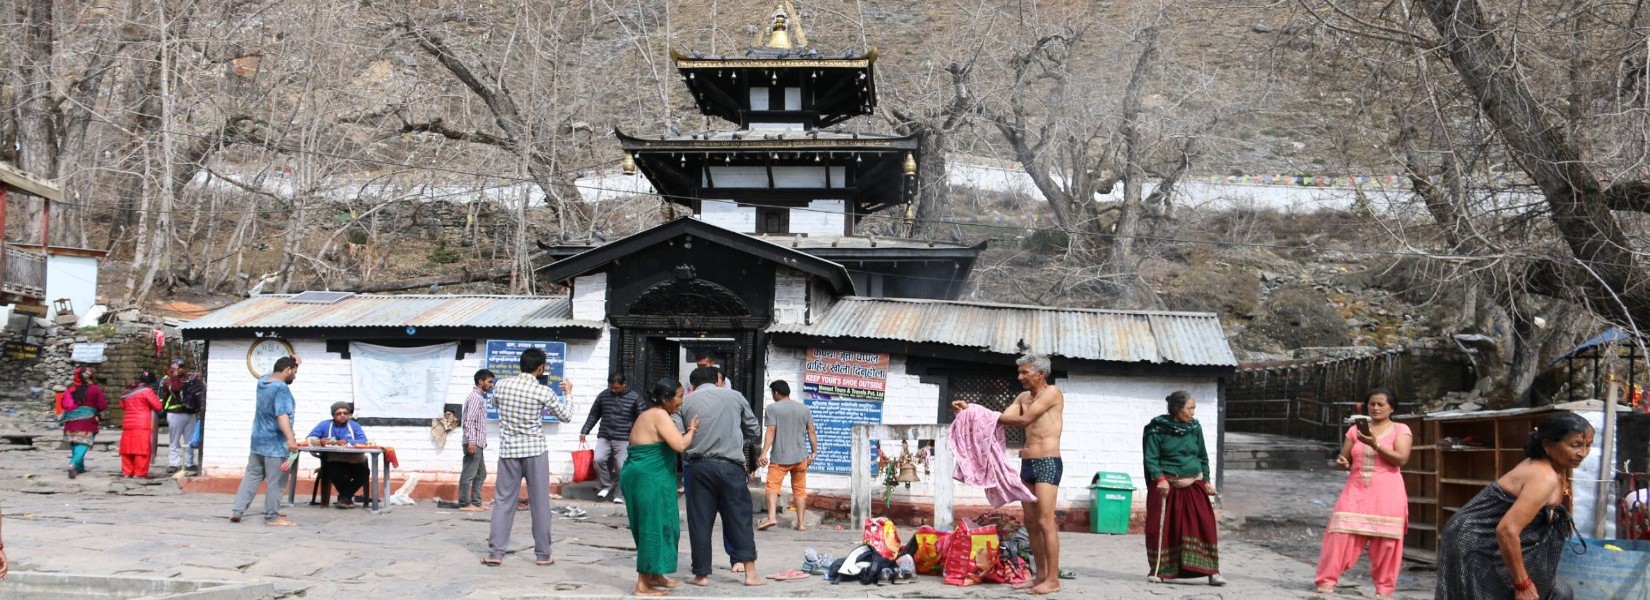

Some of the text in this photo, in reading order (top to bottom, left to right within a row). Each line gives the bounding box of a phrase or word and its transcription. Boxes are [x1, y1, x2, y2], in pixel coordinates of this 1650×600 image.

[805, 374, 883, 390] KEEP YOUR'S SHOE OUTSIDE
